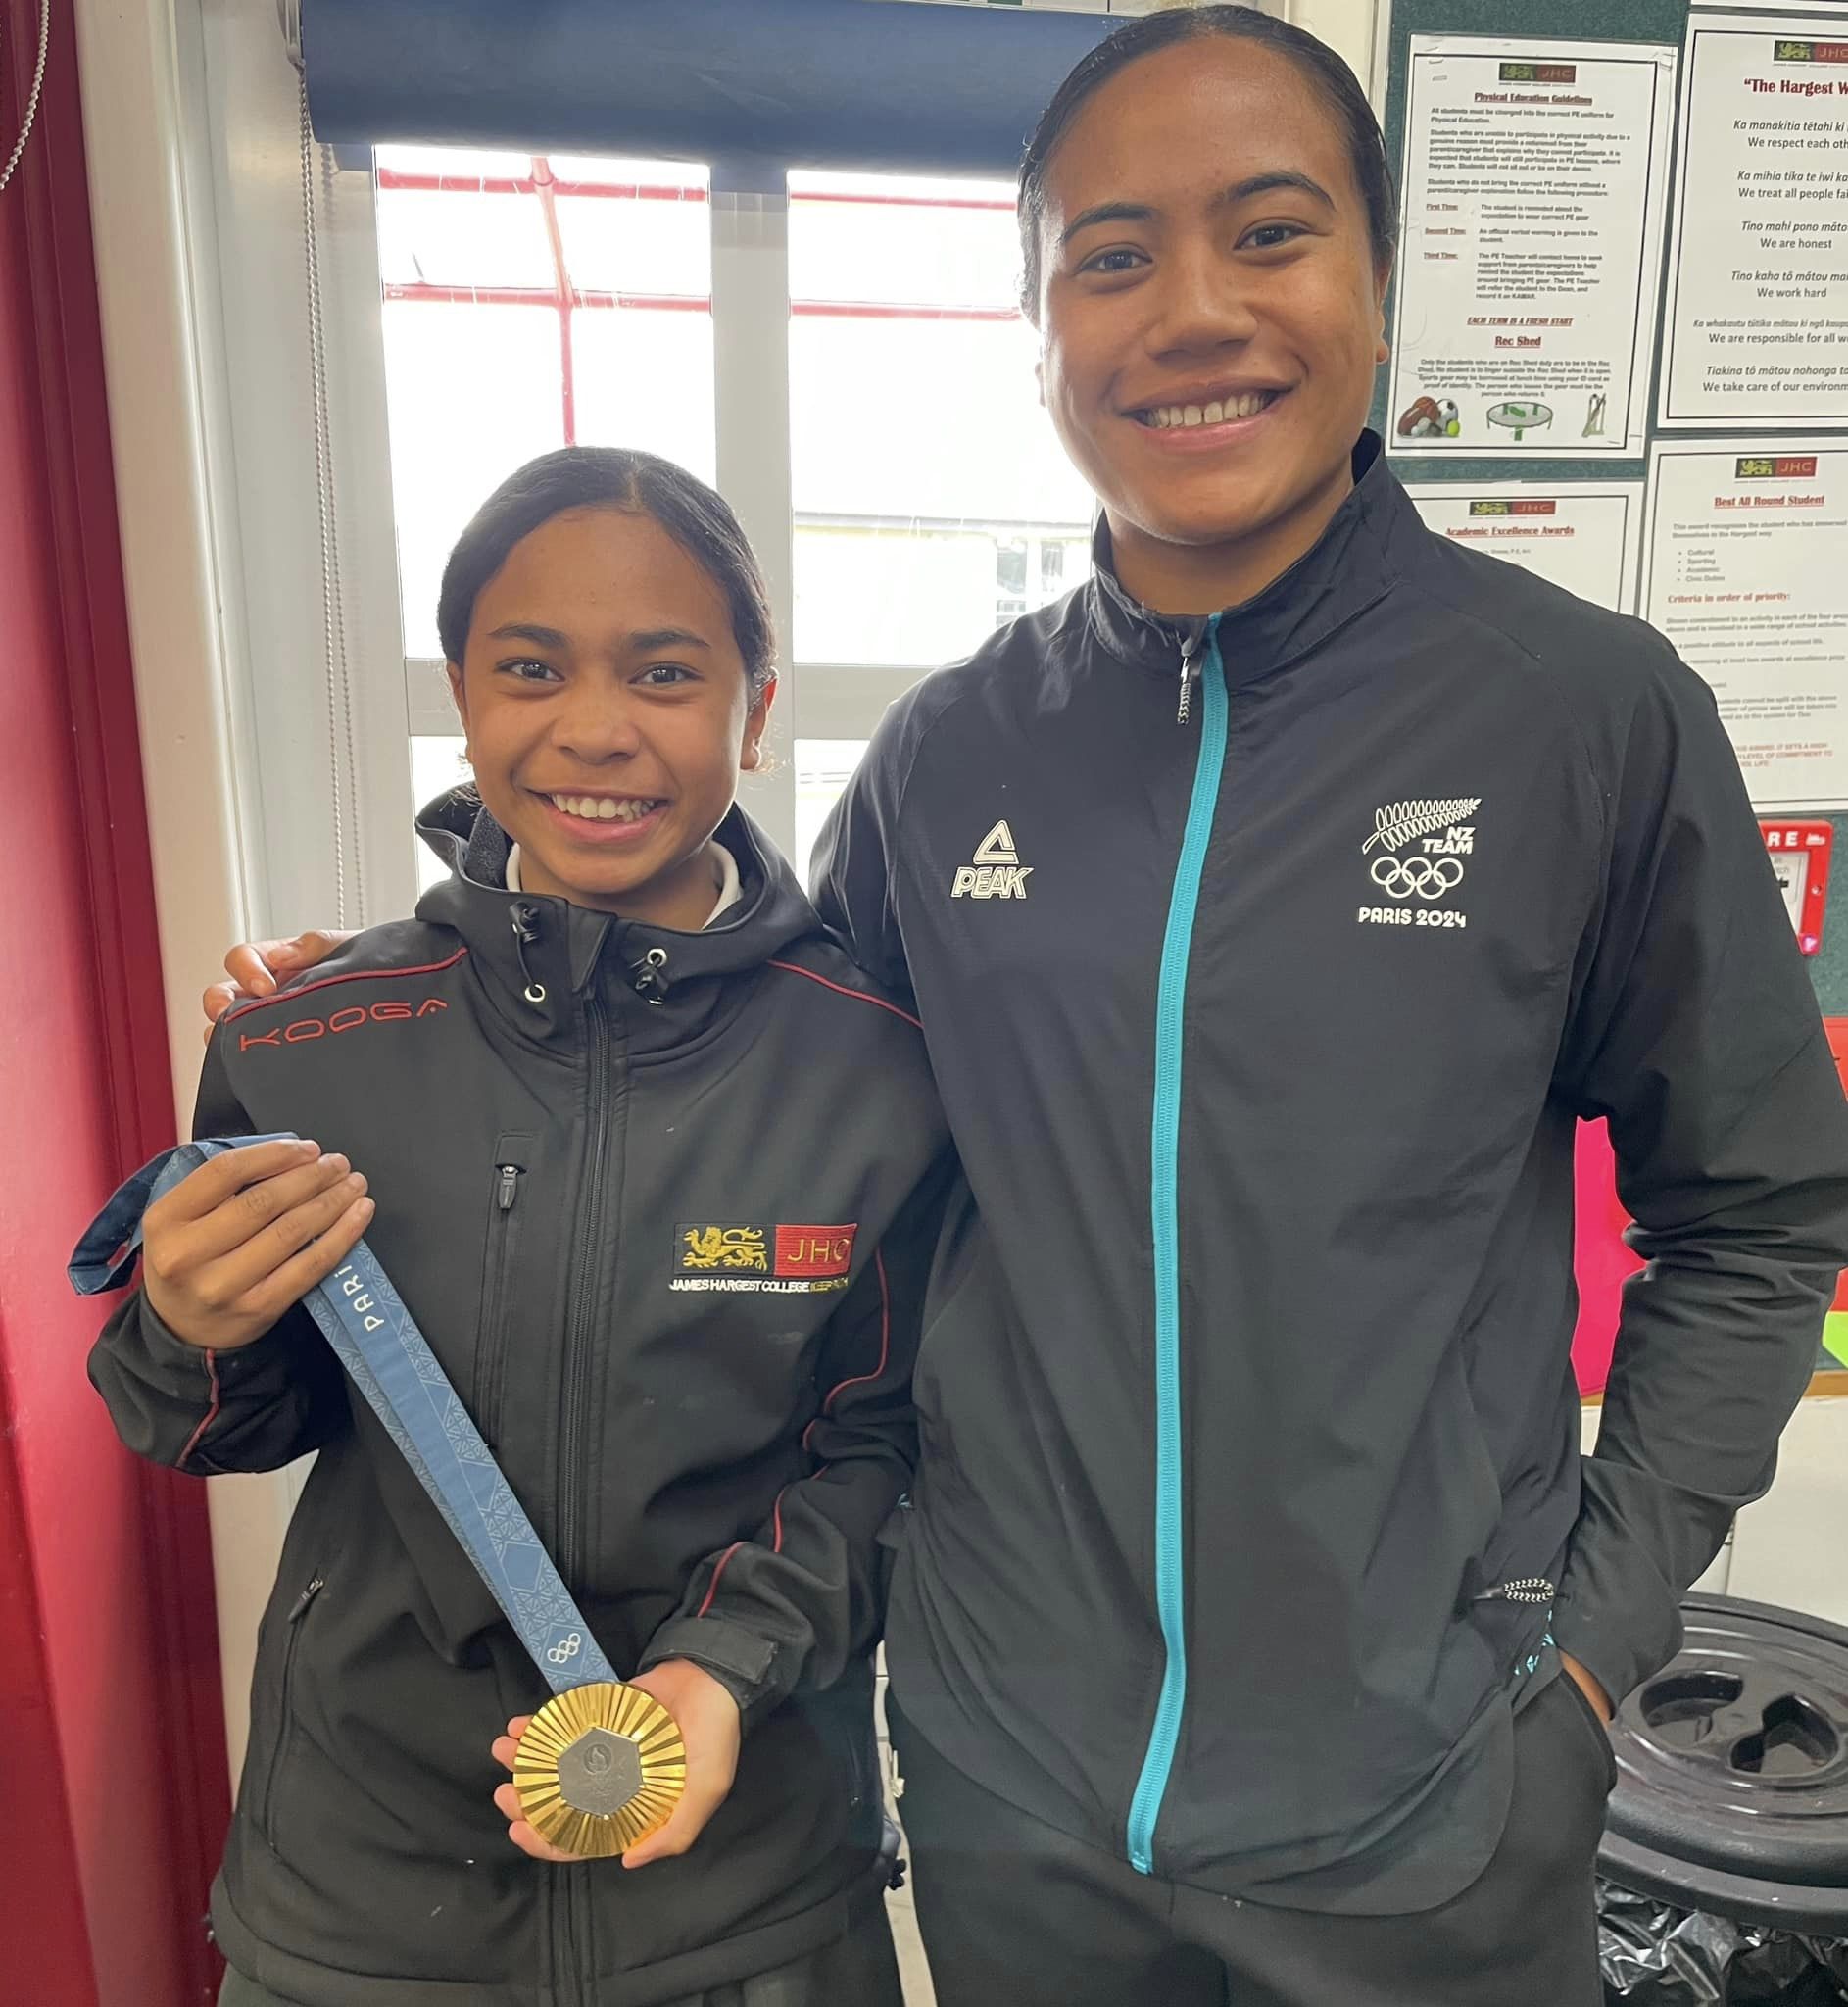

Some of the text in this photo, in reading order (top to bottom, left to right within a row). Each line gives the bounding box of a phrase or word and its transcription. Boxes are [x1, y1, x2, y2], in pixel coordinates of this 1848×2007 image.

[1819, 48, 1848, 58] JHC
[1542, 68, 1573, 79] JHC
[1780, 80, 1833, 96] Hargest
[1839, 82, 1848, 94] W
[1475, 92, 1592, 104] Physical Education Guidelines
[1733, 120, 1746, 129] Ka
[1749, 120, 1800, 130] manakitia
[1835, 122, 1843, 131] ki
[1748, 137, 1764, 147] We
[1768, 138, 1804, 149] respect
[1807, 137, 1829, 148] each
[1737, 171, 1750, 180] Ka
[1753, 171, 1781, 181] mihia
[1784, 171, 1803, 181] tika
[1806, 172, 1816, 181] te
[1819, 172, 1834, 182] iwi
[1738, 187, 1754, 197] We
[1758, 188, 1781, 198] treat
[1785, 188, 1797, 198] all
[1800, 189, 1833, 200] people
[1741, 220, 1763, 231] Tino
[1765, 221, 1791, 231] mahi
[1792, 222, 1818, 232] pono
[1760, 238, 1832, 249] We are honest
[1731, 271, 1752, 281] Tino
[1757, 287, 1826, 298] We work hard
[1495, 336, 1541, 347] Rec Shed
[1709, 333, 1726, 343] We
[1747, 333, 1804, 345] responsible
[1807, 333, 1821, 343] for
[1824, 333, 1835, 343] all
[1707, 366, 1742, 375] Tiakina
[1793, 366, 1837, 377] nohonga
[1703, 382, 1720, 392] We
[1723, 382, 1744, 392] take
[1747, 383, 1769, 392] care
[1771, 381, 1781, 392] of
[1783, 383, 1800, 392] our
[1781, 462, 1812, 472] JHC
[1715, 495, 1824, 507] Best All Round Student
[1446, 526, 1574, 536] Academic Excellence Awards
[1717, 593, 1741, 602] order
[1446, 826, 1476, 841] NZ
[1767, 831, 1798, 847] RE
[1422, 839, 1473, 854] TEAM
[950, 866, 1034, 899] PEAK
[1358, 907, 1466, 928] PARIS 2024
[240, 998, 448, 1051] KOOGA
[788, 1238, 850, 1263] JHC
[669, 1279, 708, 1292] JAMES
[710, 1279, 761, 1292] HARGEST
[762, 1280, 809, 1293] COLLEGE
[334, 1265, 384, 1331] PARi
